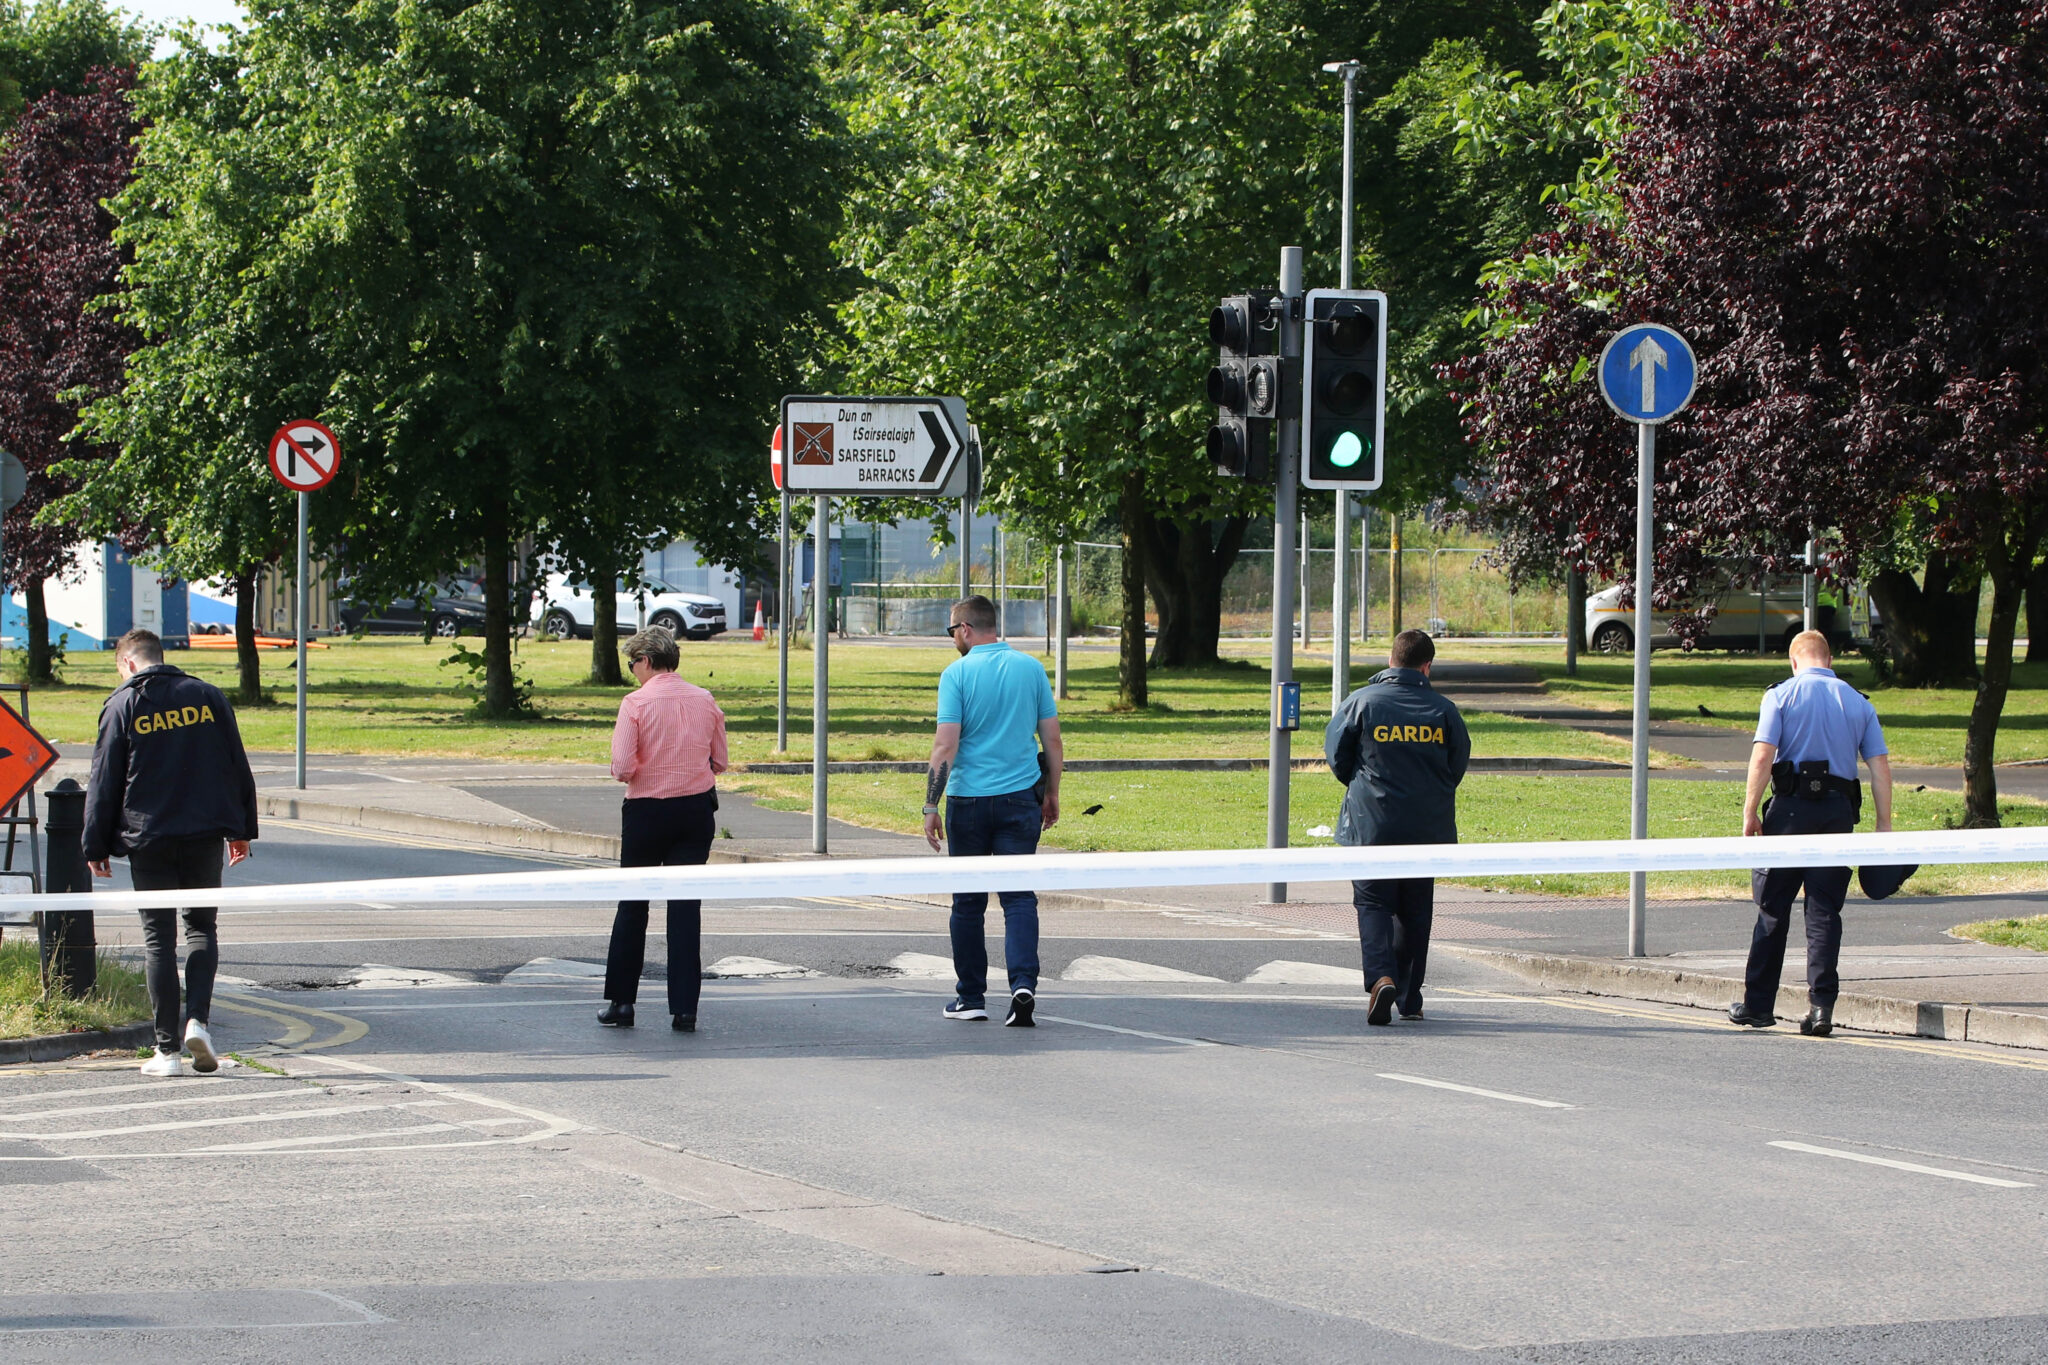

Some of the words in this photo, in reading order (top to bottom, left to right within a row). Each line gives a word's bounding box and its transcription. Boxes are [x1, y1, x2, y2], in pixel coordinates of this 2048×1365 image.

[861, 412, 872, 422] an
[838, 448, 896, 462] SARSFIELD
[859, 468, 915, 482] BARRACKS
[134, 705, 215, 735] GARDA
[1373, 725, 1444, 744] GARDA
